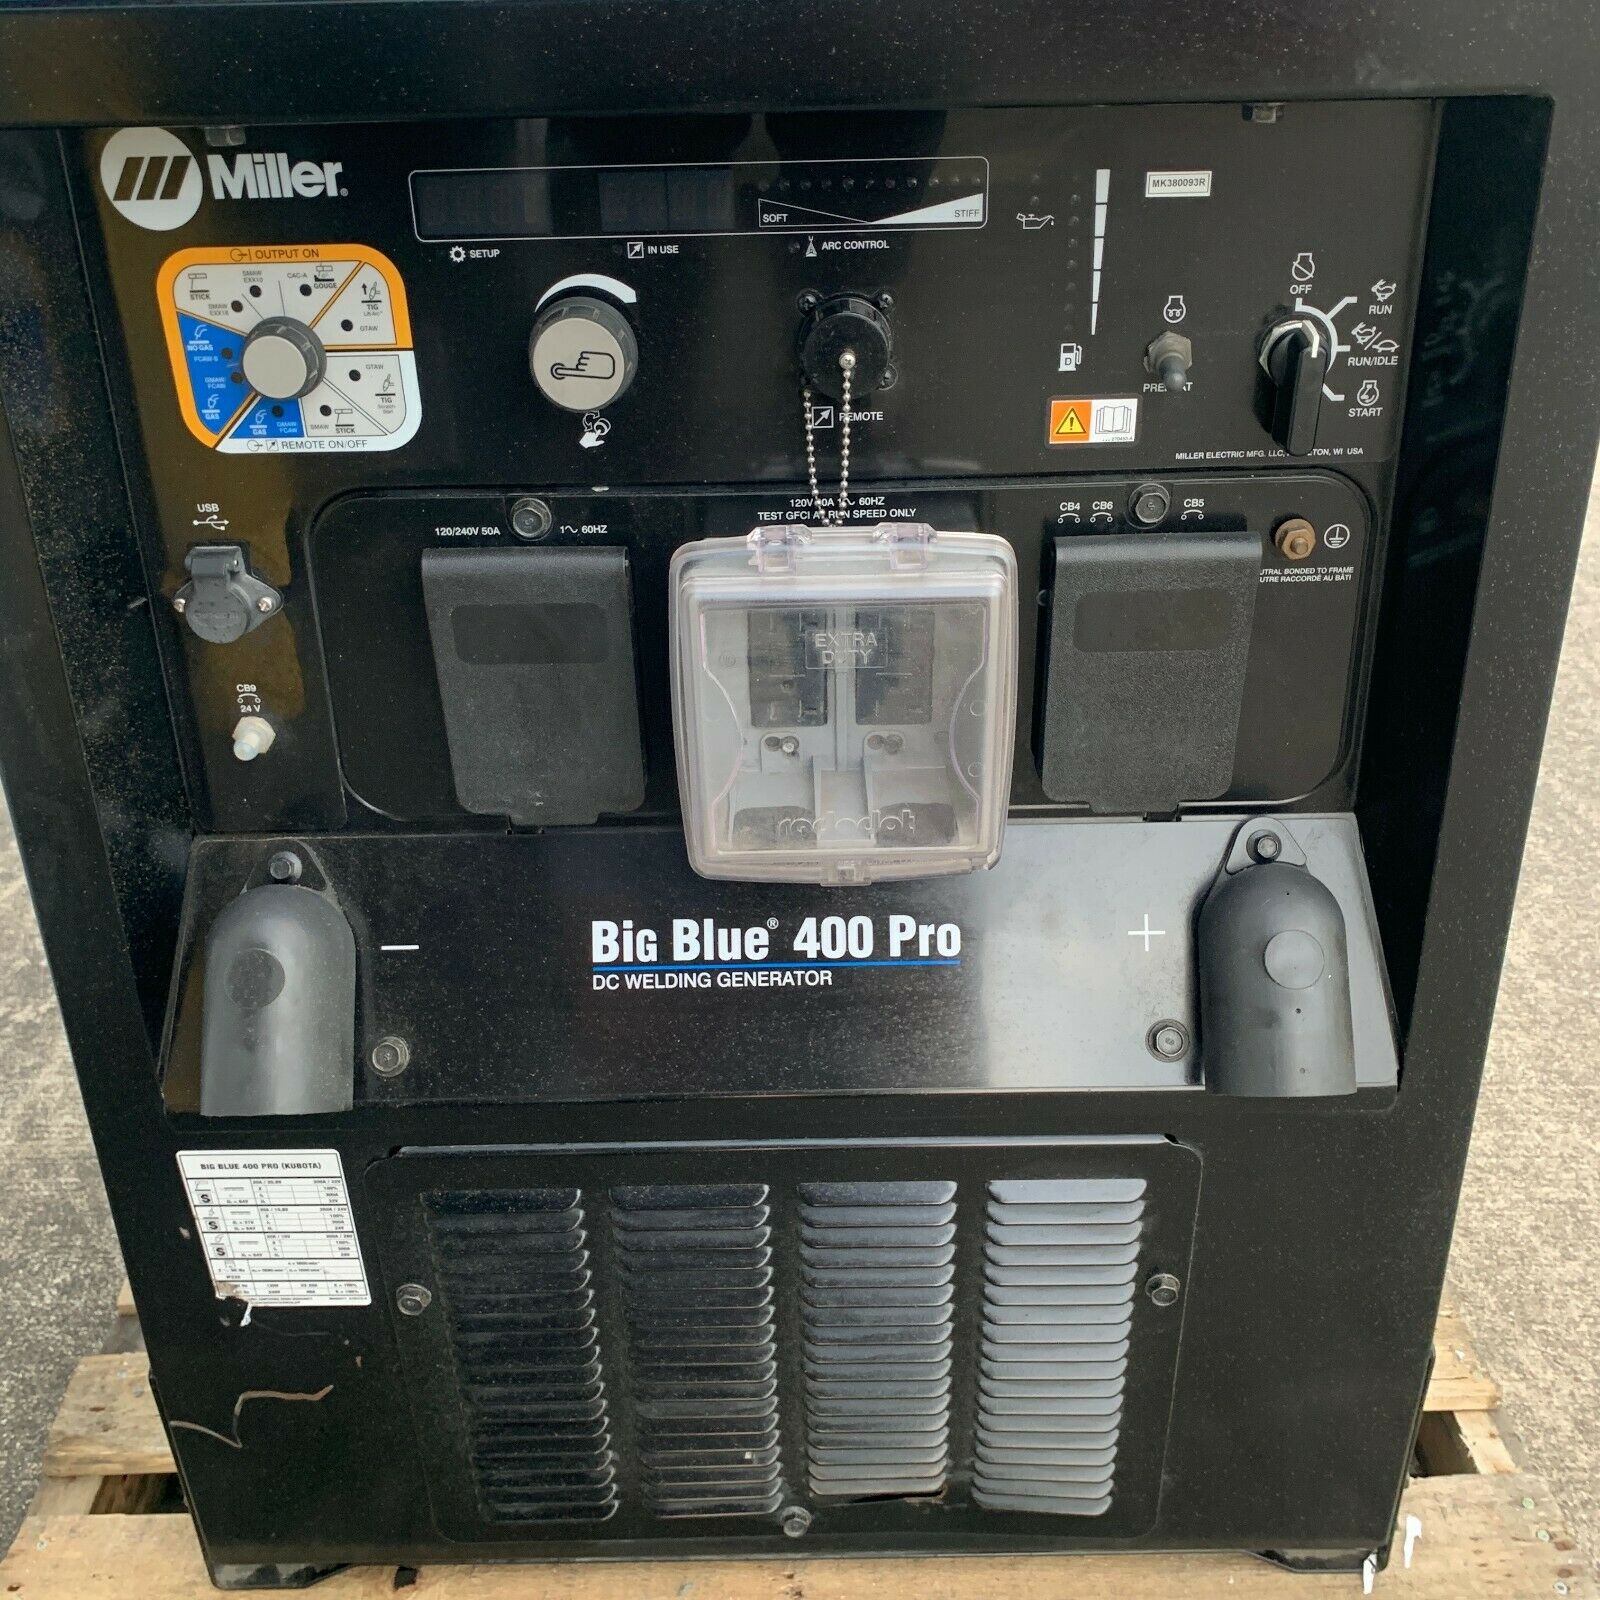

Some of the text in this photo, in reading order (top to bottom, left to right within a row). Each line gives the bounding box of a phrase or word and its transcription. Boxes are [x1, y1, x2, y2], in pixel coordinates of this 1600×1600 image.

[1151, 178, 1206, 188] MK380093R
[762, 213, 788, 223] SOFT
[953, 208, 980, 219] STIFF
[647, 244, 680, 255] IN USE
[821, 239, 890, 251] ARC CONTROL
[255, 248, 320, 260] OUTPUT ON
[469, 249, 500, 259] SETUP
[1289, 284, 1313, 295] OFF
[190, 293, 211, 301] STICK
[366, 303, 379, 311] TIG
[1368, 304, 1393, 315] RUN
[1347, 356, 1399, 367] RUN/IDLE
[1142, 381, 1194, 393] PRET
[1348, 407, 1383, 418] START
[281, 439, 368, 450] REMOTE ON/OFF
[1175, 452, 1205, 460] MILLER
[1206, 450, 1245, 459] ELECTRIC
[1246, 449, 1265, 458] MFG.
[1332, 448, 1344, 456] WI
[1346, 447, 1363, 456] USA
[789, 499, 814, 508] 120V
[819, 497, 835, 507] 0A
[858, 496, 885, 506] 60HZ
[1059, 502, 1081, 511] CB4
[1092, 500, 1113, 510] CB6
[1183, 498, 1204, 508] CB5
[197, 503, 220, 513] USB
[757, 511, 783, 520] TEST
[785, 510, 811, 520] GFCI
[813, 510, 822, 519] A
[853, 509, 888, 519] SPEED
[889, 508, 917, 518] ONLY
[434, 526, 501, 536] 120/240V 50A
[581, 525, 608, 534] 60HZ
[1284, 567, 1316, 575] BONDED
[1328, 566, 1354, 574] FRAME
[1280, 574, 1322, 582] RACCORDÉ
[814, 631, 878, 648] EXTRA
[821, 649, 873, 665] DTY
[236, 684, 257, 692] CB9
[240, 704, 261, 713] 24 V
[792, 915, 874, 959] 400
[889, 914, 962, 957] Pro
[592, 970, 833, 991] DC WELDING GENERATOR
[281, 1162, 322, 1170] (KUBOTA)
[200, 1193, 211, 1203] S
[208, 1221, 218, 1230] S
[216, 1247, 226, 1256] S
